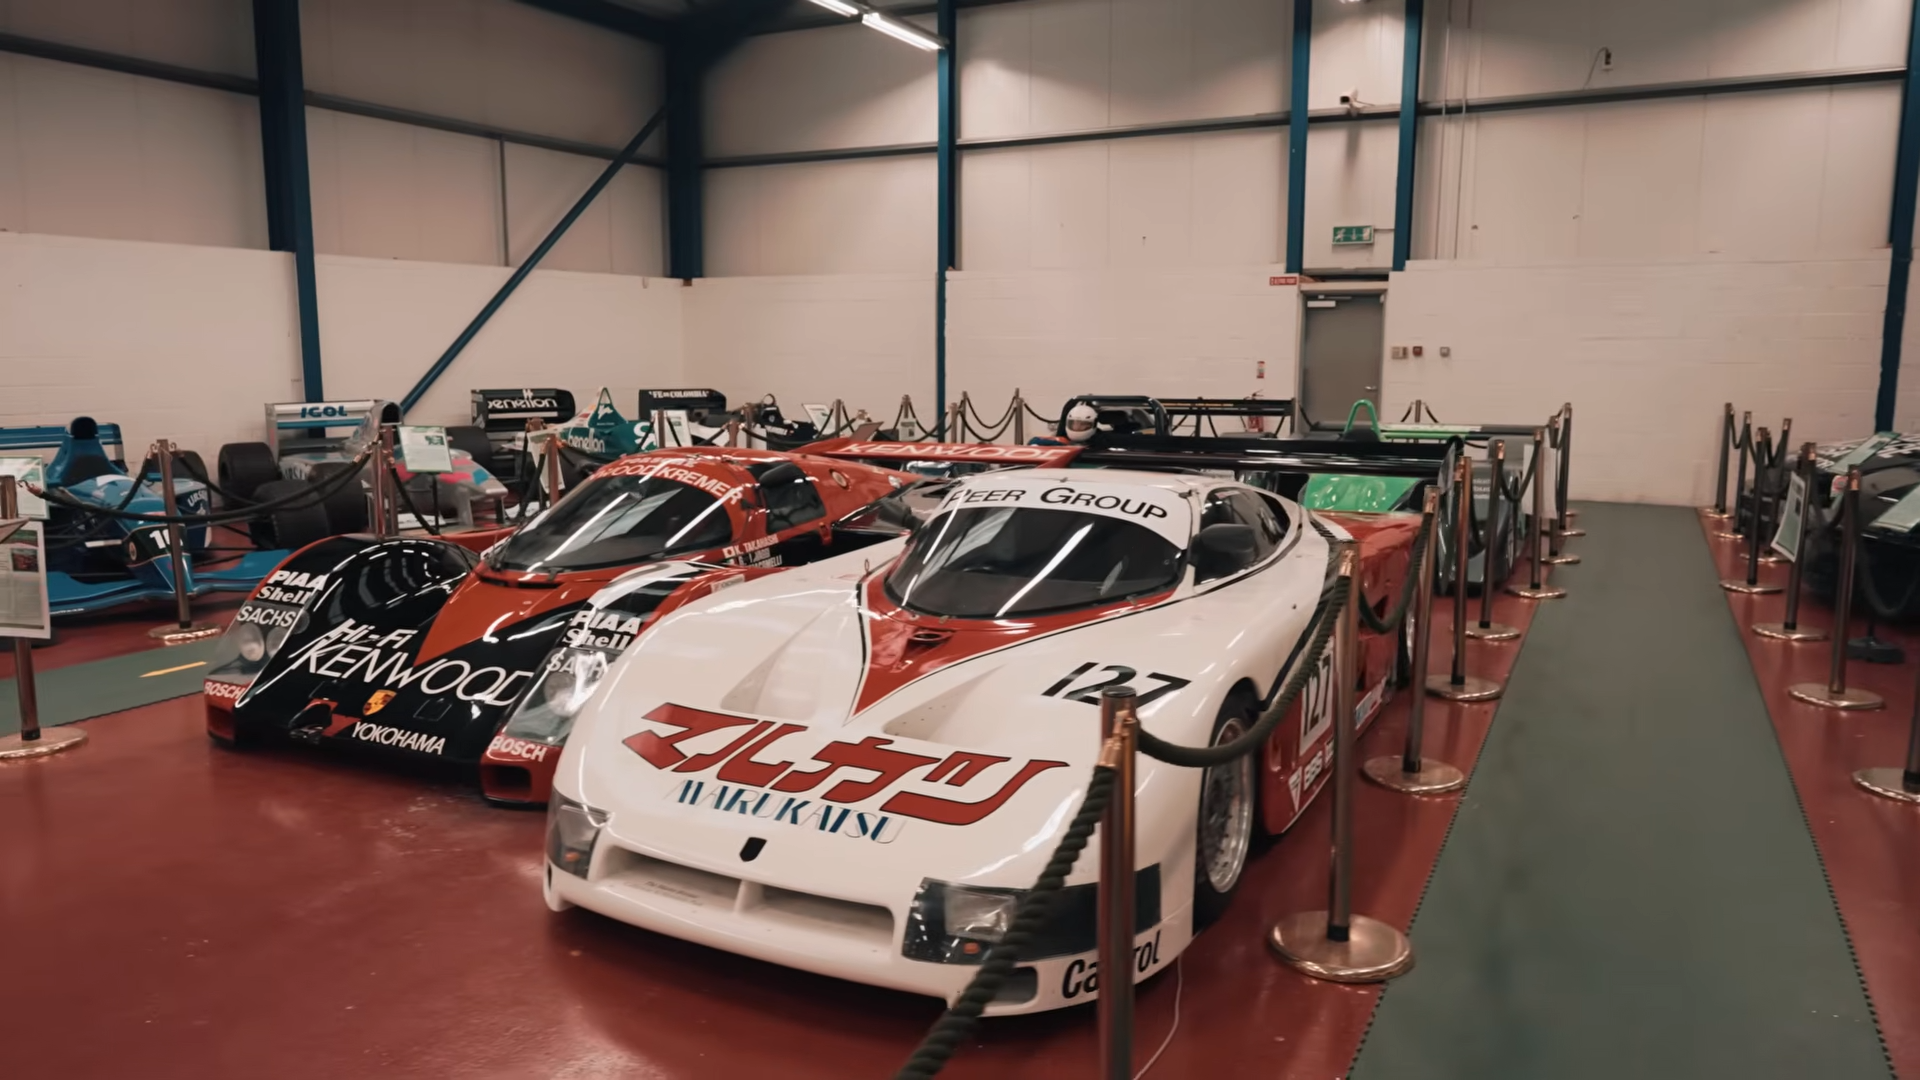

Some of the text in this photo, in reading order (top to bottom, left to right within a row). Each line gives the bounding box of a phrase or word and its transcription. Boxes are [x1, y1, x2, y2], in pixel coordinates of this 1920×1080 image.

[301, 405, 347, 418] IGOL
[657, 466, 743, 504] KREMER
[942, 487, 1168, 519] PEER GROUP
[267, 570, 325, 591] PIAA
[256, 586, 311, 605] Shell
[237, 606, 296, 627] SACHS
[570, 610, 642, 635] PIAA
[326, 618, 418, 649] Hi-Fi
[562, 628, 631, 650] Shell
[292, 636, 534, 706] KENWOOD
[1041, 662, 1192, 708] 127
[204, 681, 246, 699] BOSCH
[1303, 654, 1331, 737] 127
[352, 722, 445, 755] YOKOHAMA
[488, 736, 547, 762] BOSCH
[663, 780, 906, 843] MARUKATSU
